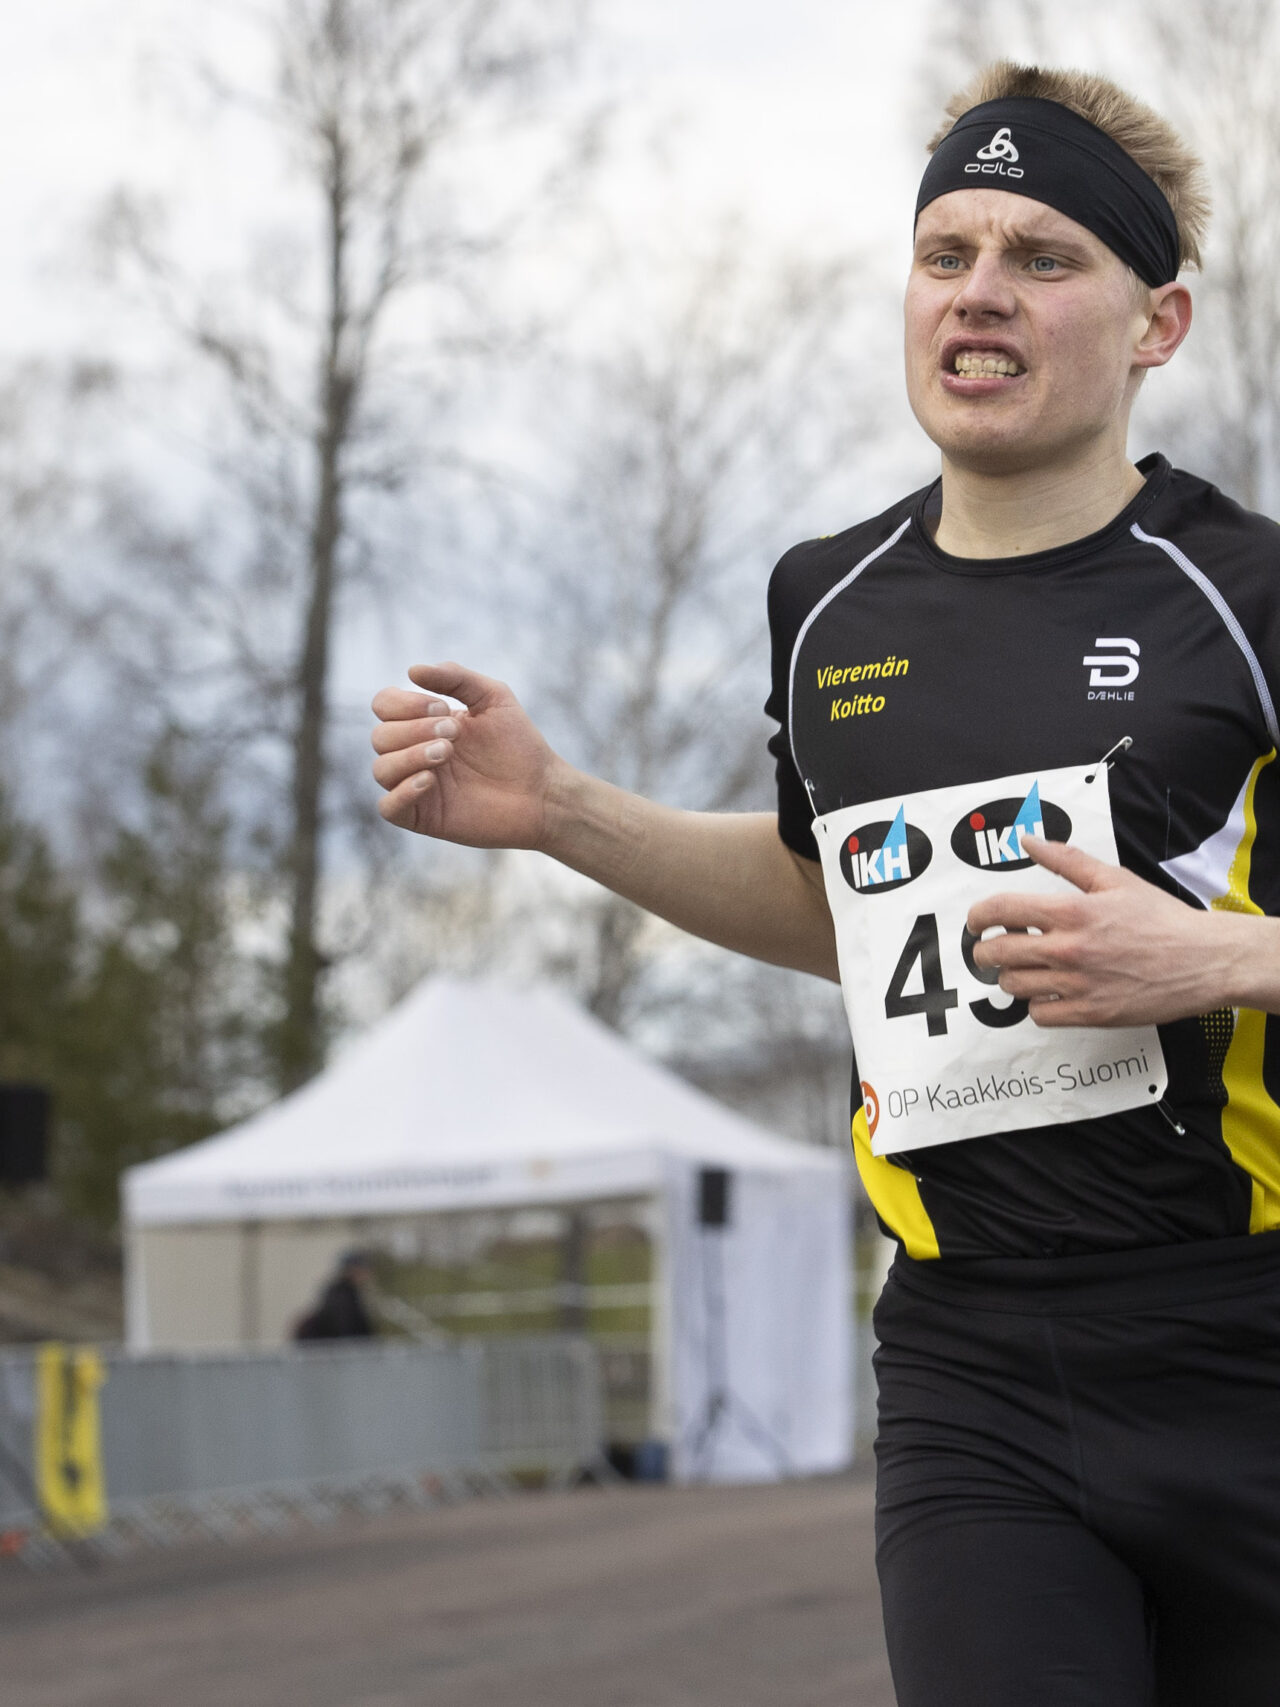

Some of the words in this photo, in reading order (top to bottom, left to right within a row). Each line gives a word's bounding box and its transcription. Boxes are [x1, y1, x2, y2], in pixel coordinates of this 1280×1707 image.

[964, 162, 1025, 179] odlo
[816, 656, 910, 690] Vieremän
[830, 694, 886, 722] Koitto
[888, 1087, 920, 1119] OP
[927, 1048, 1150, 1114] Kaakkois-Suomi
